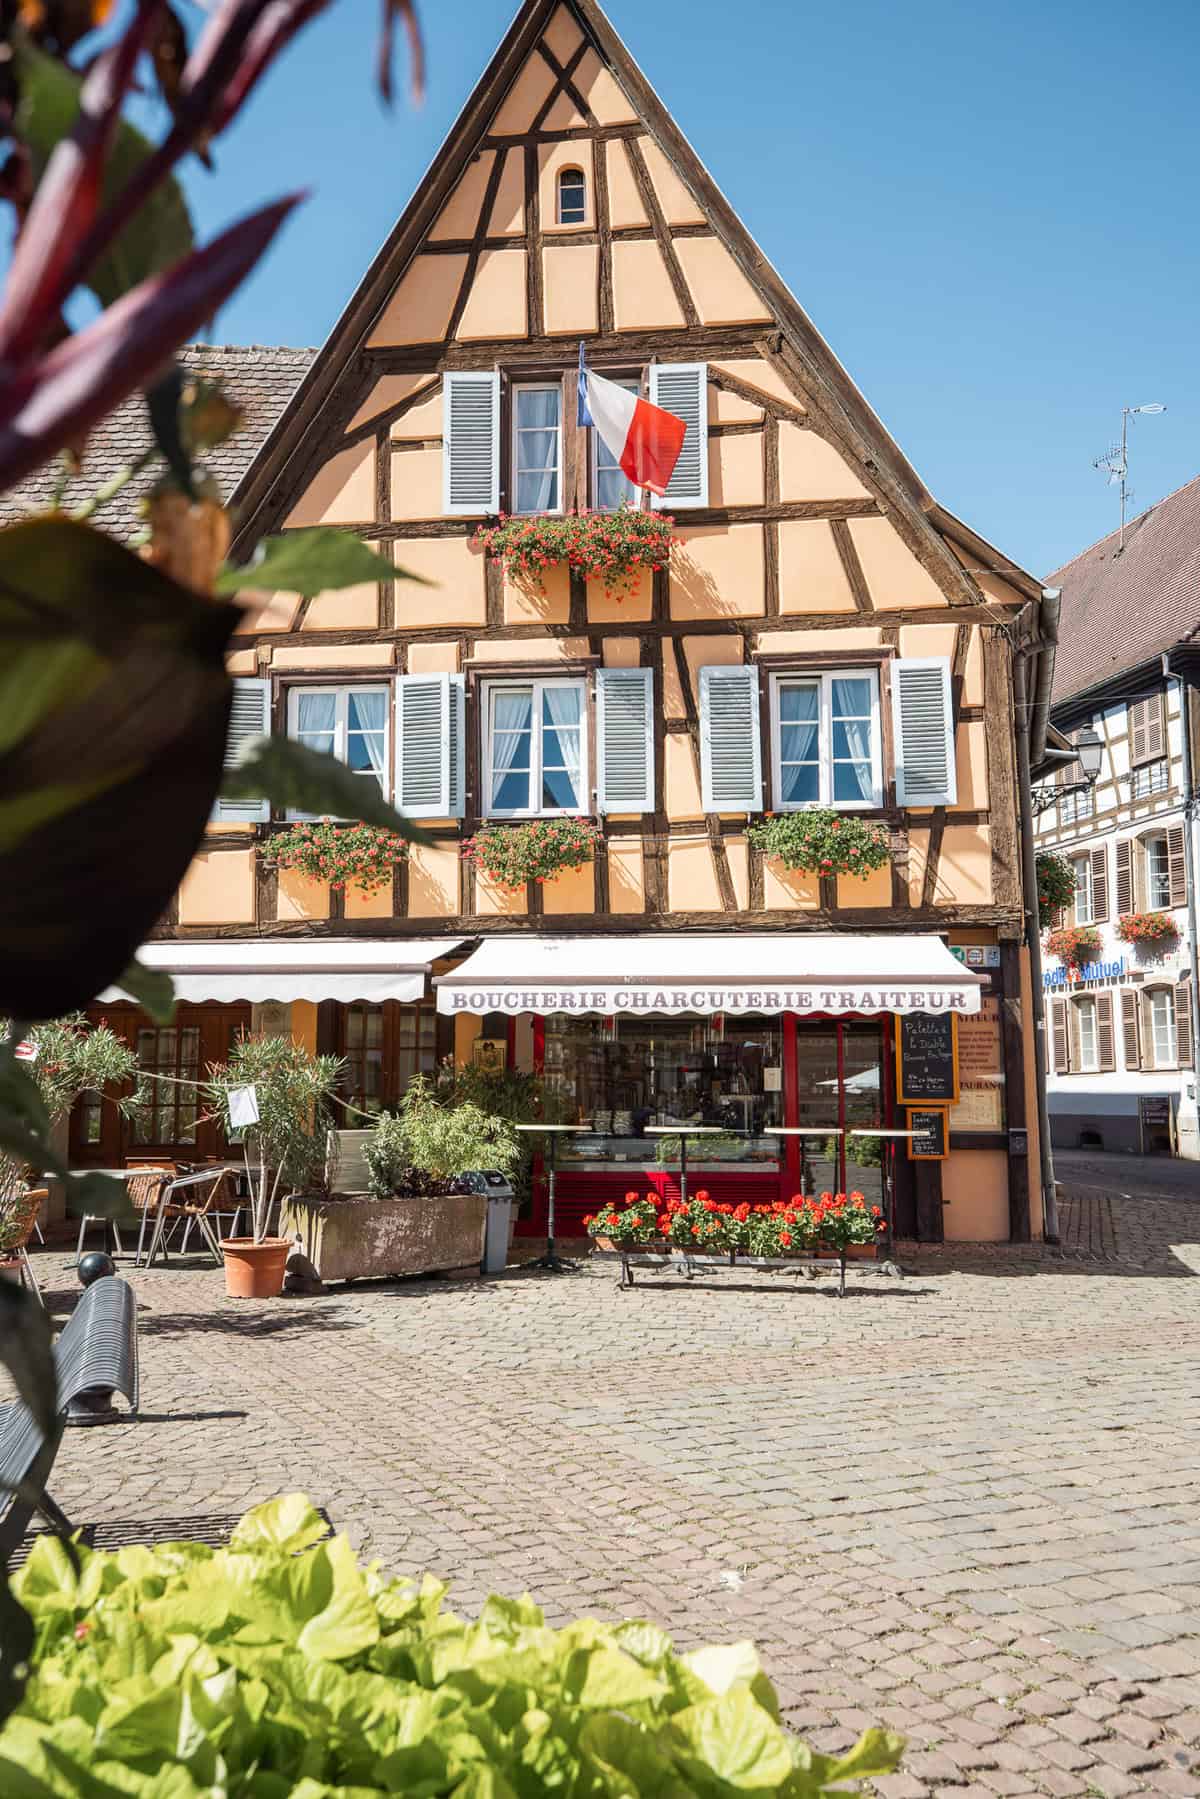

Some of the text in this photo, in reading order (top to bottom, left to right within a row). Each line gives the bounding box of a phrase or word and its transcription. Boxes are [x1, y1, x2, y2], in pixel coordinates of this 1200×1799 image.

[1081, 955, 1124, 980] Mutuel
[451, 991, 607, 1009] BOUCHERIE
[613, 991, 813, 1008] CHARCUTERIE
[820, 991, 967, 1008] TRAITEUR
